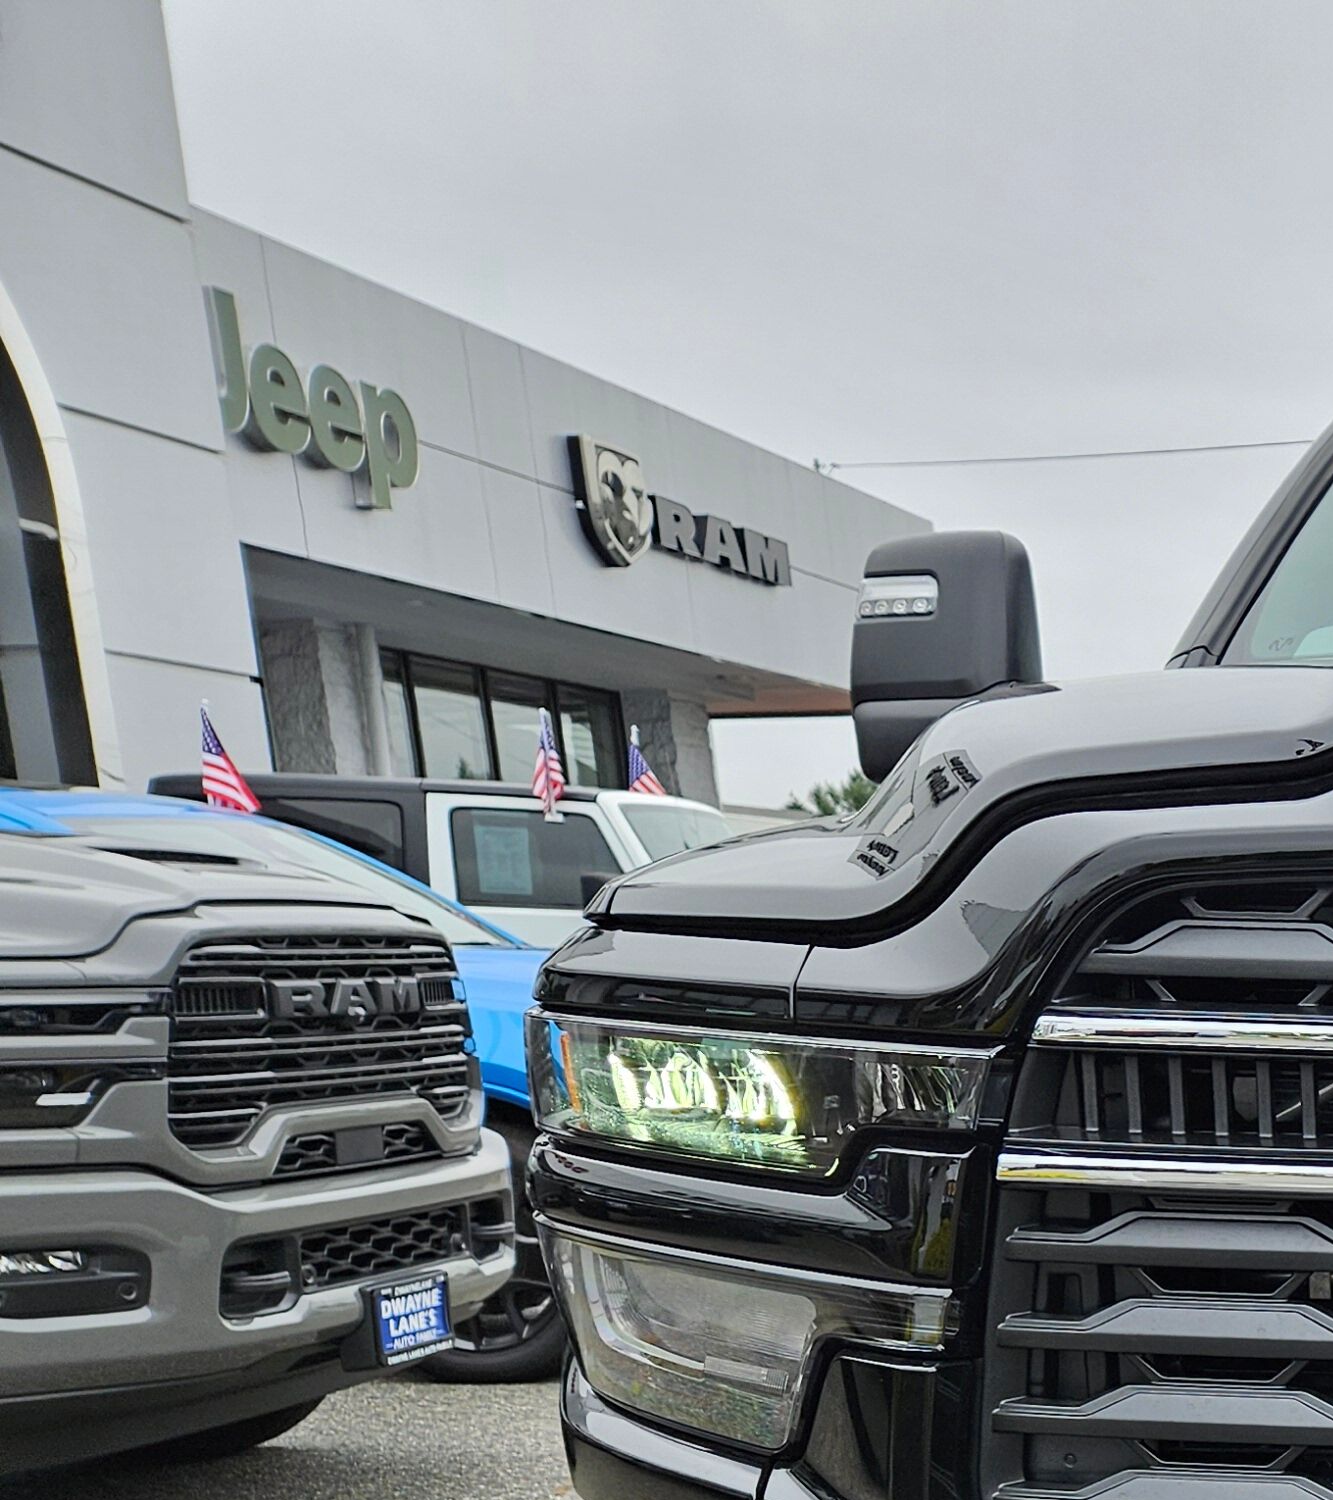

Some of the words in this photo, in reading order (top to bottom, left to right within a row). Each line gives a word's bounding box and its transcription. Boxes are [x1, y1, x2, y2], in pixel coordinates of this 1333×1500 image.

[202, 285, 419, 510] Jeep
[647, 493, 792, 587] RAM
[268, 975, 422, 1019] RAM
[380, 1287, 443, 1319] DWAYNE
[389, 1308, 438, 1338] LANE'S
